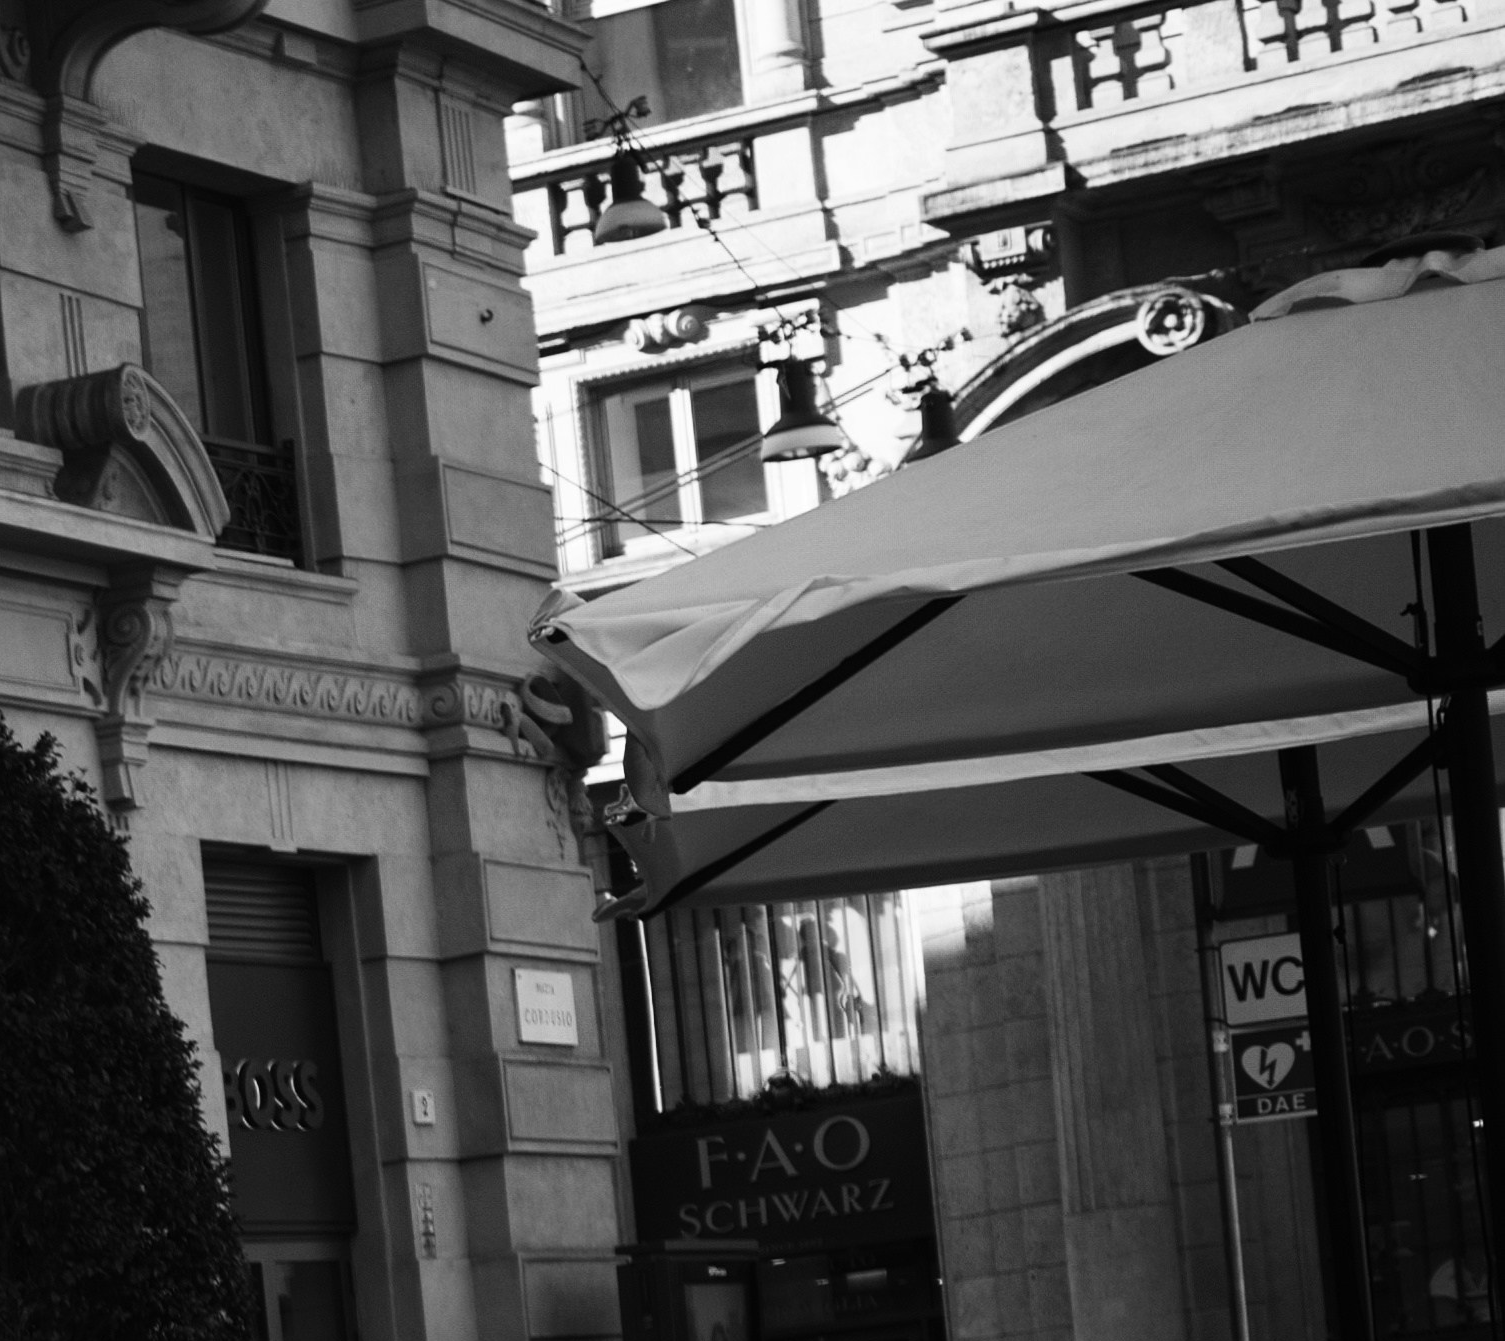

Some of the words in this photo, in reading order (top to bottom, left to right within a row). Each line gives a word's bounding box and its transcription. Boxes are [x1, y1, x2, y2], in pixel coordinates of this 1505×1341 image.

[1227, 956, 1306, 1001] WC
[1257, 1093, 1307, 1115] DAE
[678, 1177, 895, 1239] SCHWARZ
